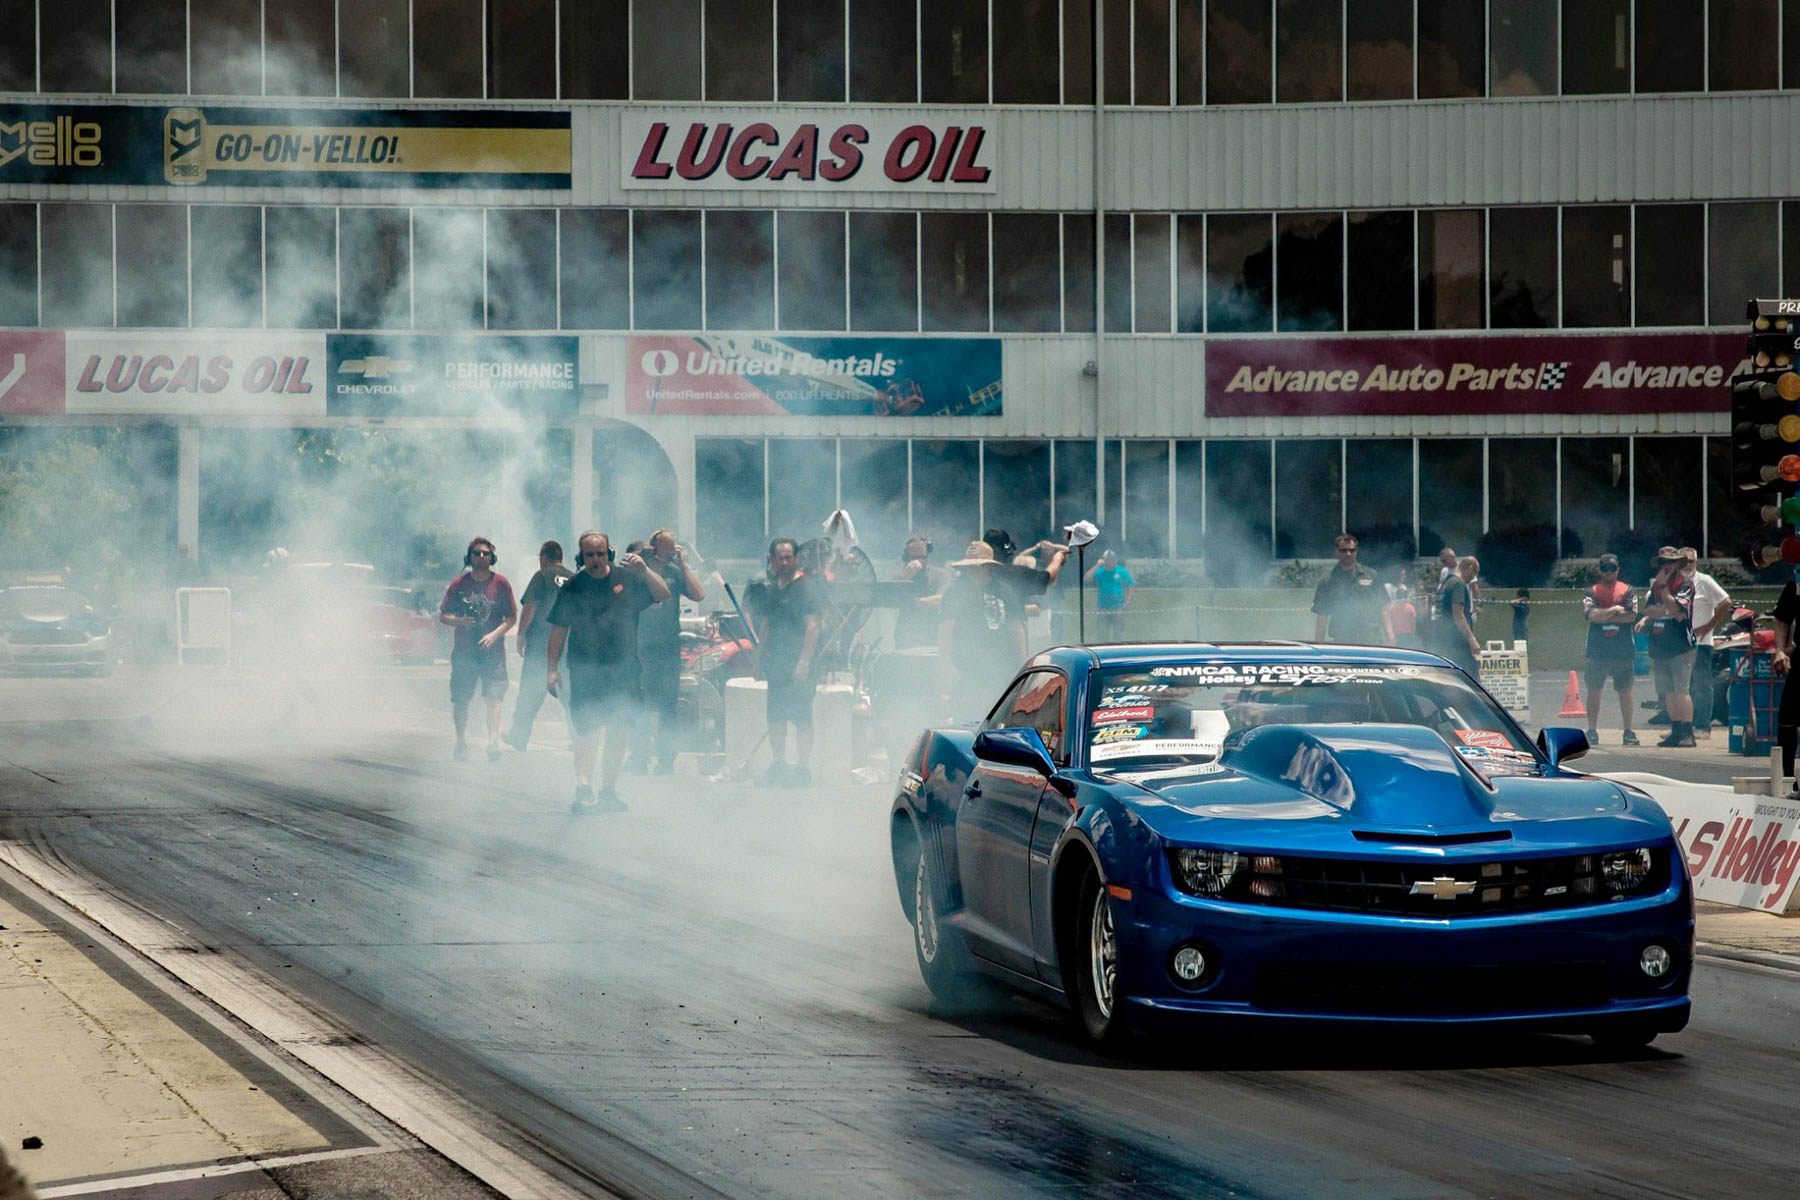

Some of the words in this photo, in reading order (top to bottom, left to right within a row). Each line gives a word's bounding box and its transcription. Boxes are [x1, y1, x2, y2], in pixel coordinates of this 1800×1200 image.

[215, 133, 399, 164] GO-ON-YELLO!
[631, 122, 869, 181] LUCAS
[884, 125, 991, 183] OIL
[77, 354, 233, 394] LUCAS
[242, 355, 313, 394] OIL
[445, 362, 574, 379] PERFORMANCE
[686, 350, 785, 375] United
[790, 352, 897, 377] Rentals
[1583, 361, 1723, 389] Advance
[337, 384, 417, 395] CHEVROLET
[1225, 365, 1359, 393] Advance
[1360, 364, 1445, 391] Auto
[1445, 362, 1538, 390] Parts
[1165, 666, 1237, 676] NMCA
[1242, 666, 1325, 675] RACING
[1480, 659, 1521, 670] ANGER
[1199, 674, 1256, 685] Holley
[1711, 816, 1800, 908] Holley
